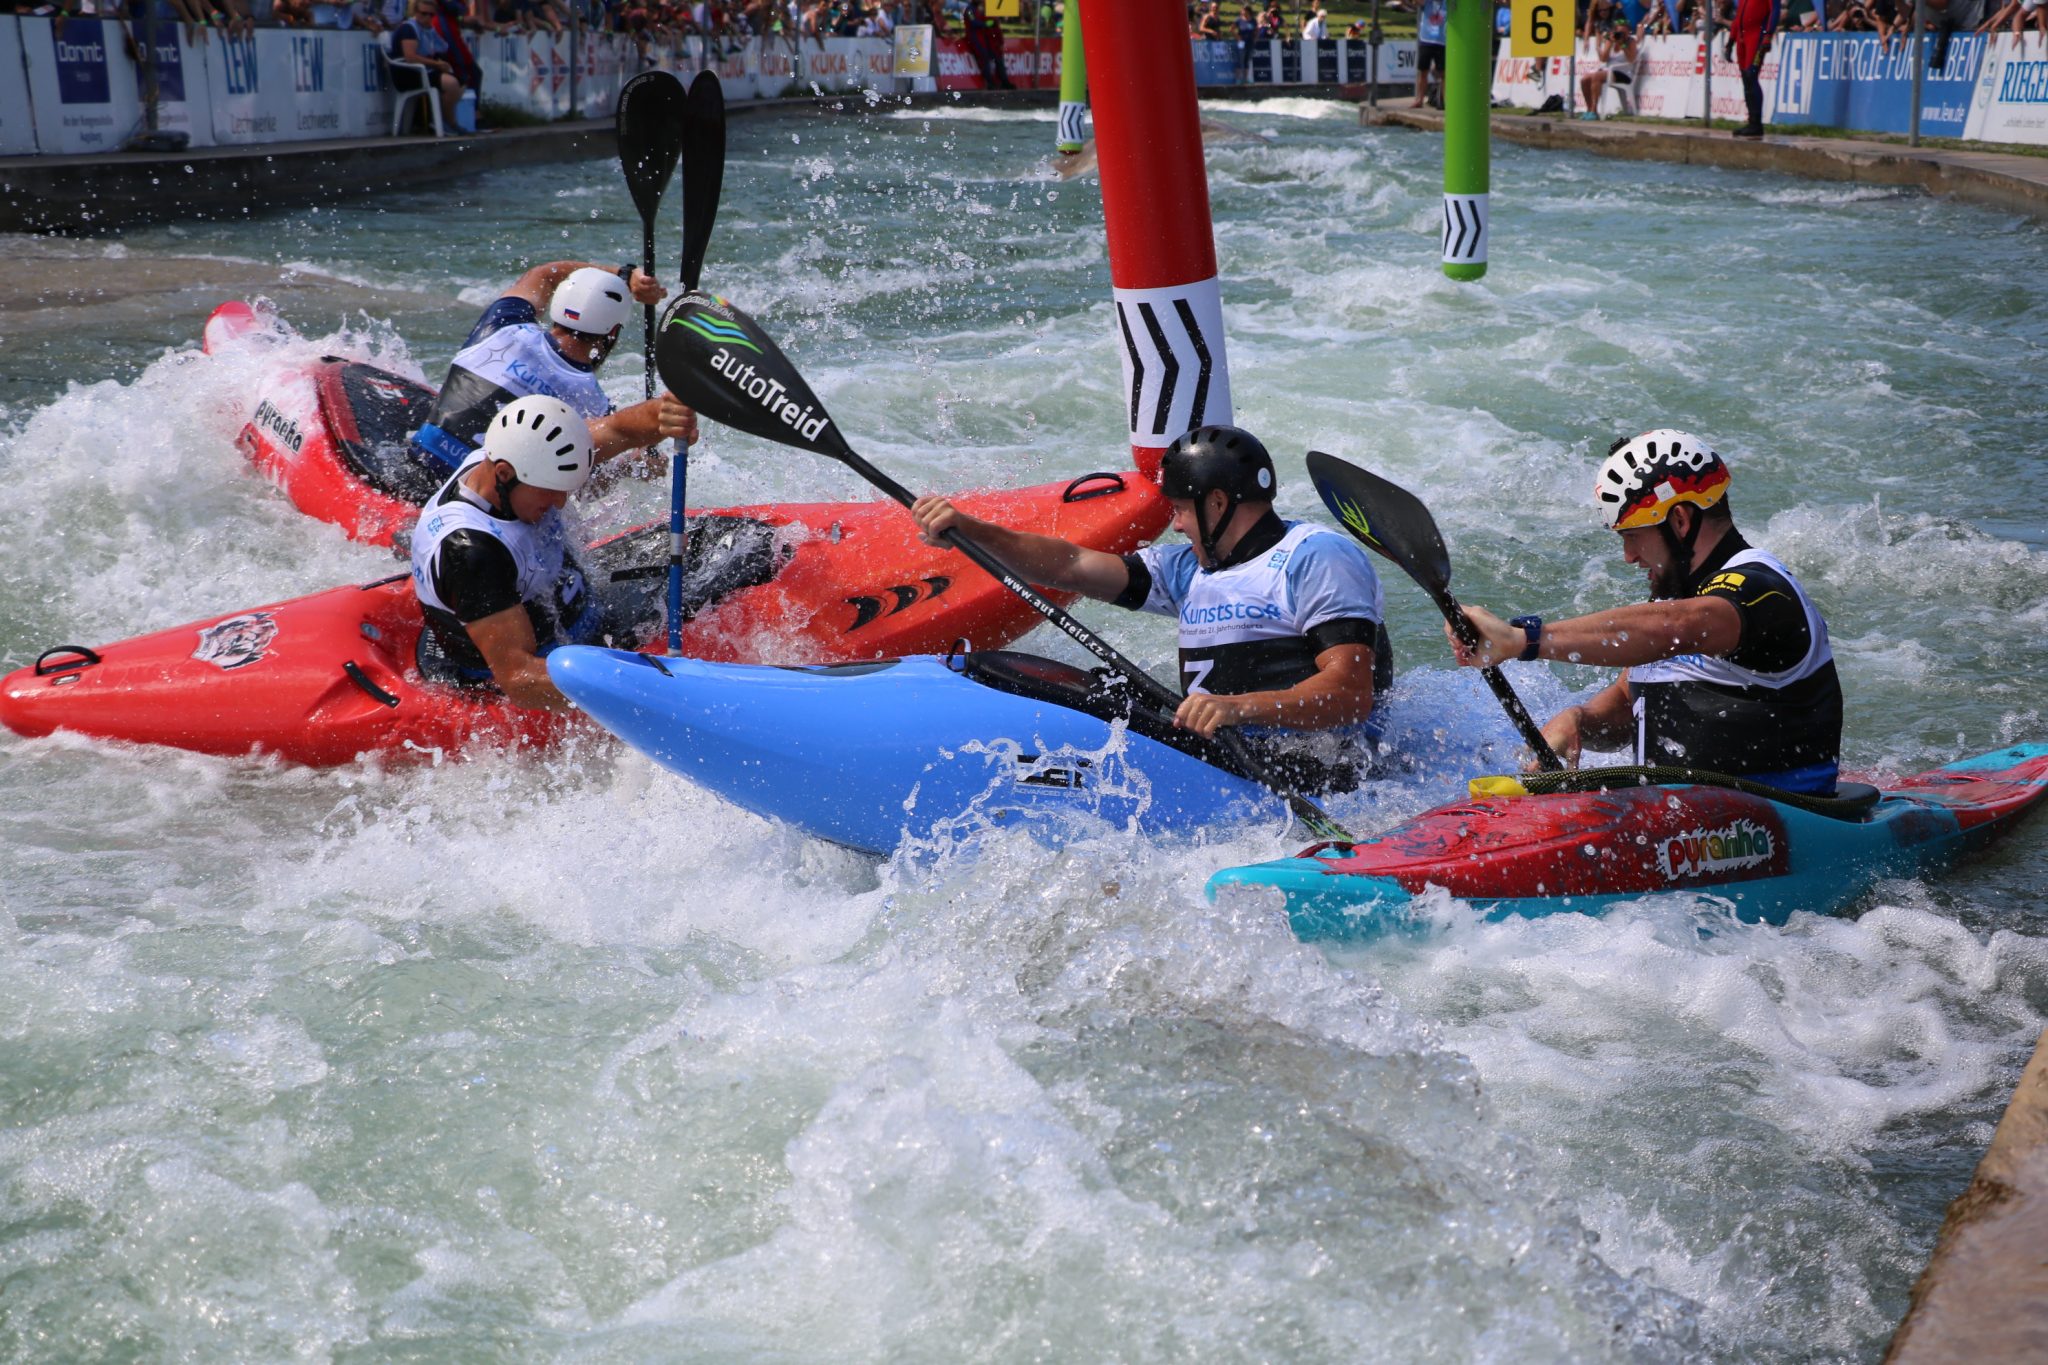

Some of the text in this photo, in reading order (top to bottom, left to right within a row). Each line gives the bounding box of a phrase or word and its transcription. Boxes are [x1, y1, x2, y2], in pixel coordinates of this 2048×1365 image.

[1532, 5, 1553, 45] 6
[220, 36, 258, 94] LEW
[293, 37, 324, 92] LEW
[760, 55, 790, 77] KUKA
[811, 54, 847, 74] KUKA
[870, 55, 893, 74] KU
[1777, 38, 1818, 115] LEW
[1818, 38, 1884, 81] ENERGIE
[1998, 60, 2048, 103] RIEGE
[231, 112, 277, 135] Lechwerke
[298, 106, 339, 131] Lechwerke
[1922, 102, 1966, 123] www.lew.de
[710, 347, 829, 442] autoTreid
[1632, 696, 1646, 767] 1
[1667, 821, 1770, 876] pyranha
